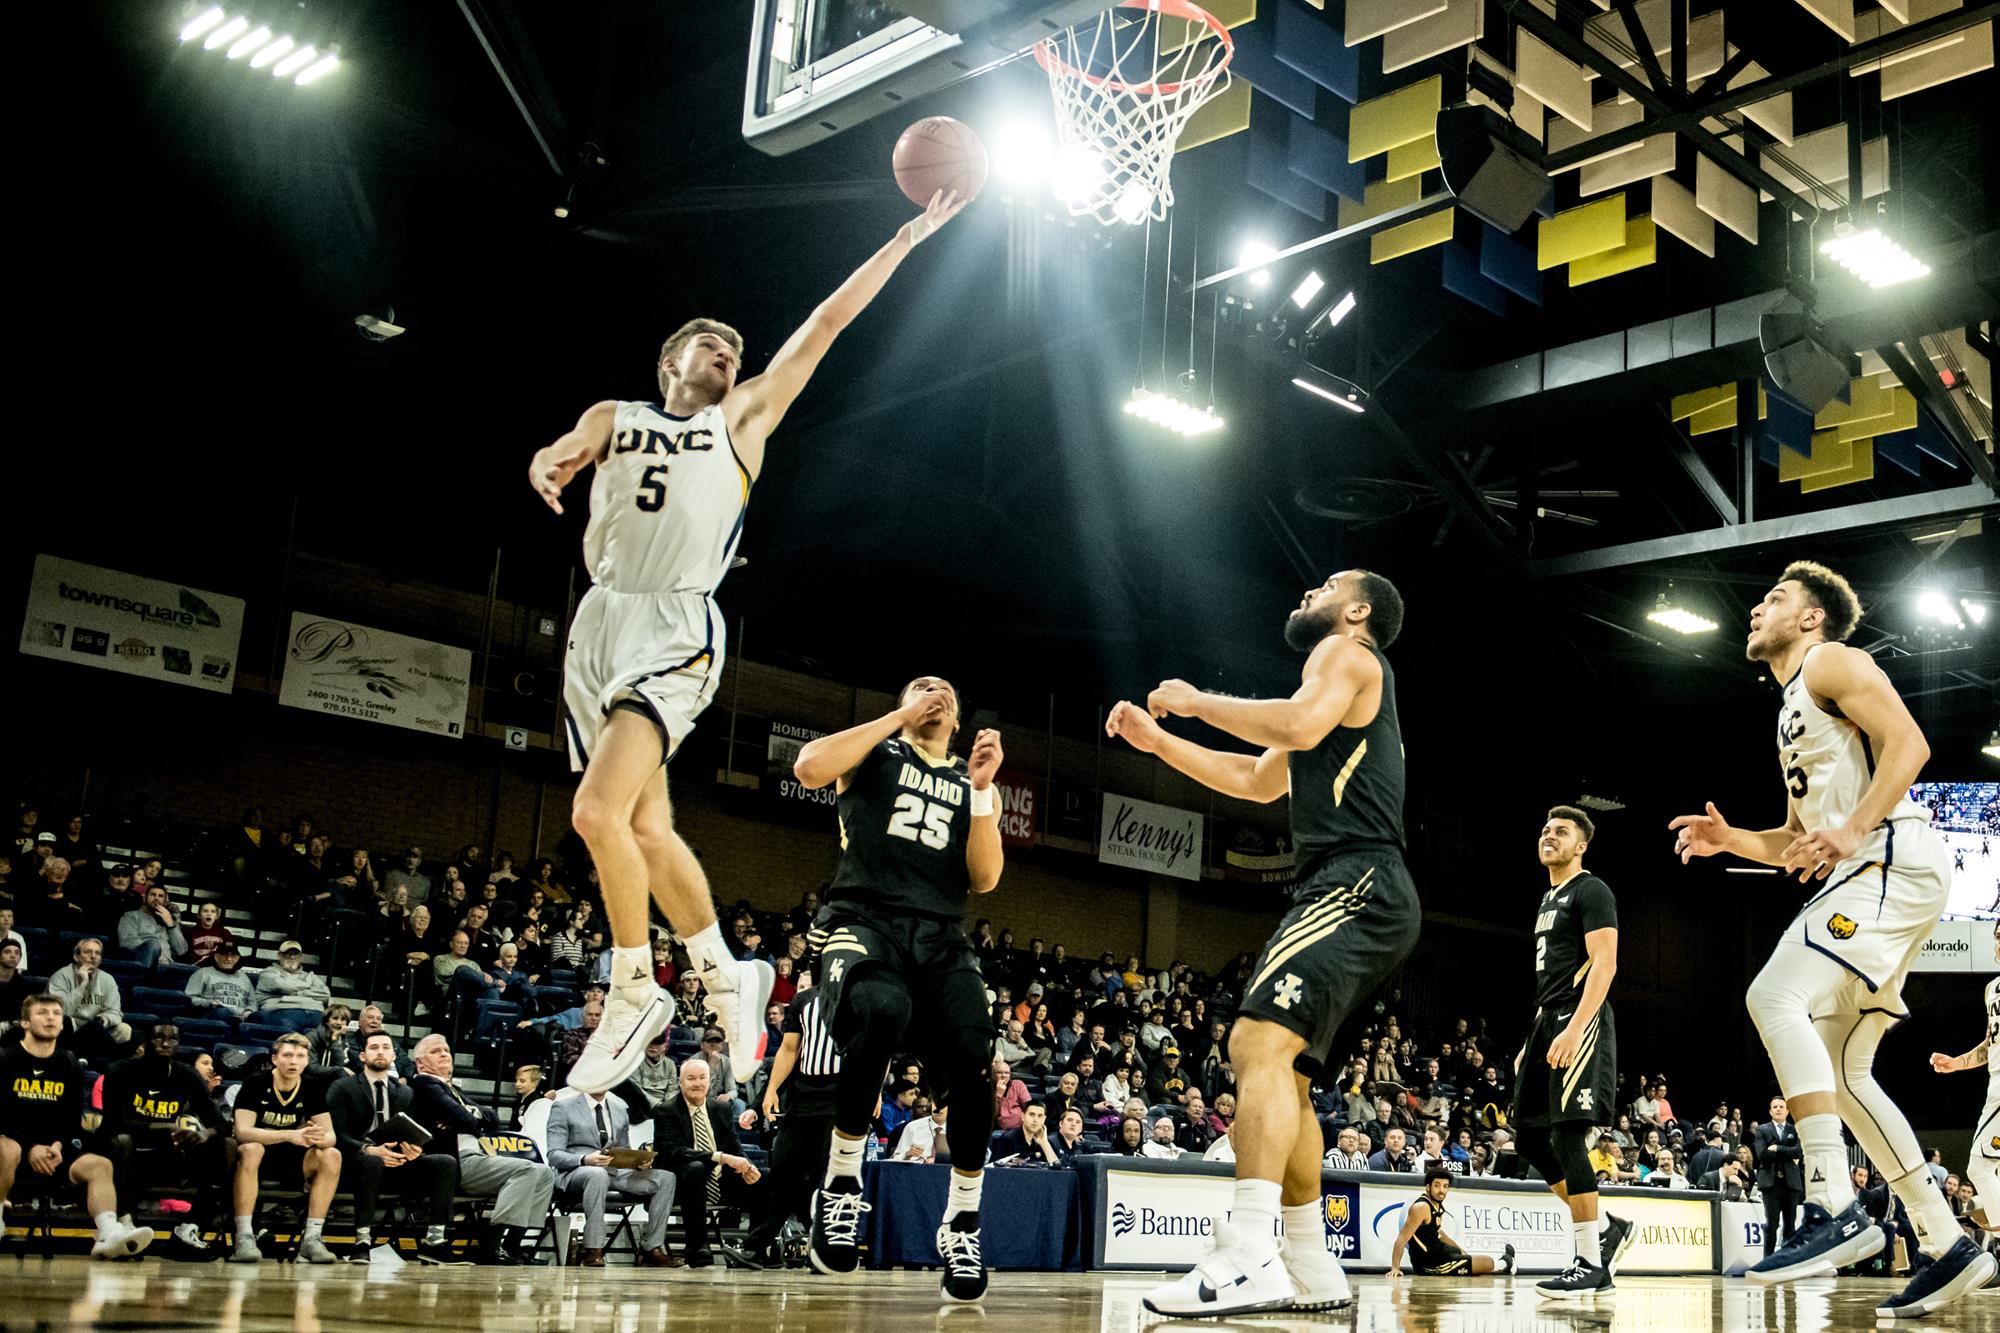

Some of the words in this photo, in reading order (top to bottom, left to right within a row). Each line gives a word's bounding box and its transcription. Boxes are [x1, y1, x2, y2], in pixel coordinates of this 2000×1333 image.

[615, 428, 724, 457] UNC
[636, 464, 679, 513] 5
[58, 582, 195, 625] townsquare
[307, 689, 329, 700] 2400
[330, 692, 349, 704] 17th
[365, 700, 398, 715] Greeley
[322, 702, 380, 719] 970.515.5332
[510, 731, 523, 746] C
[1780, 709, 1806, 747] NC
[780, 779, 836, 806] 970-330
[898, 763, 964, 807] IDAHO
[886, 793, 955, 851] 25
[1108, 802, 1196, 868] Kenny's
[1107, 843, 1136, 857] STEAK
[1137, 848, 1167, 863] HOUSE
[1261, 870, 1297, 883] BOWLIN
[1922, 938, 1969, 952] olorado
[13, 1077, 65, 1098] IDAHO
[1442, 1160, 1464, 1172] POSS
[1140, 1207, 1215, 1236] Banne
[1640, 1225, 1710, 1246] ADVANTAGE
